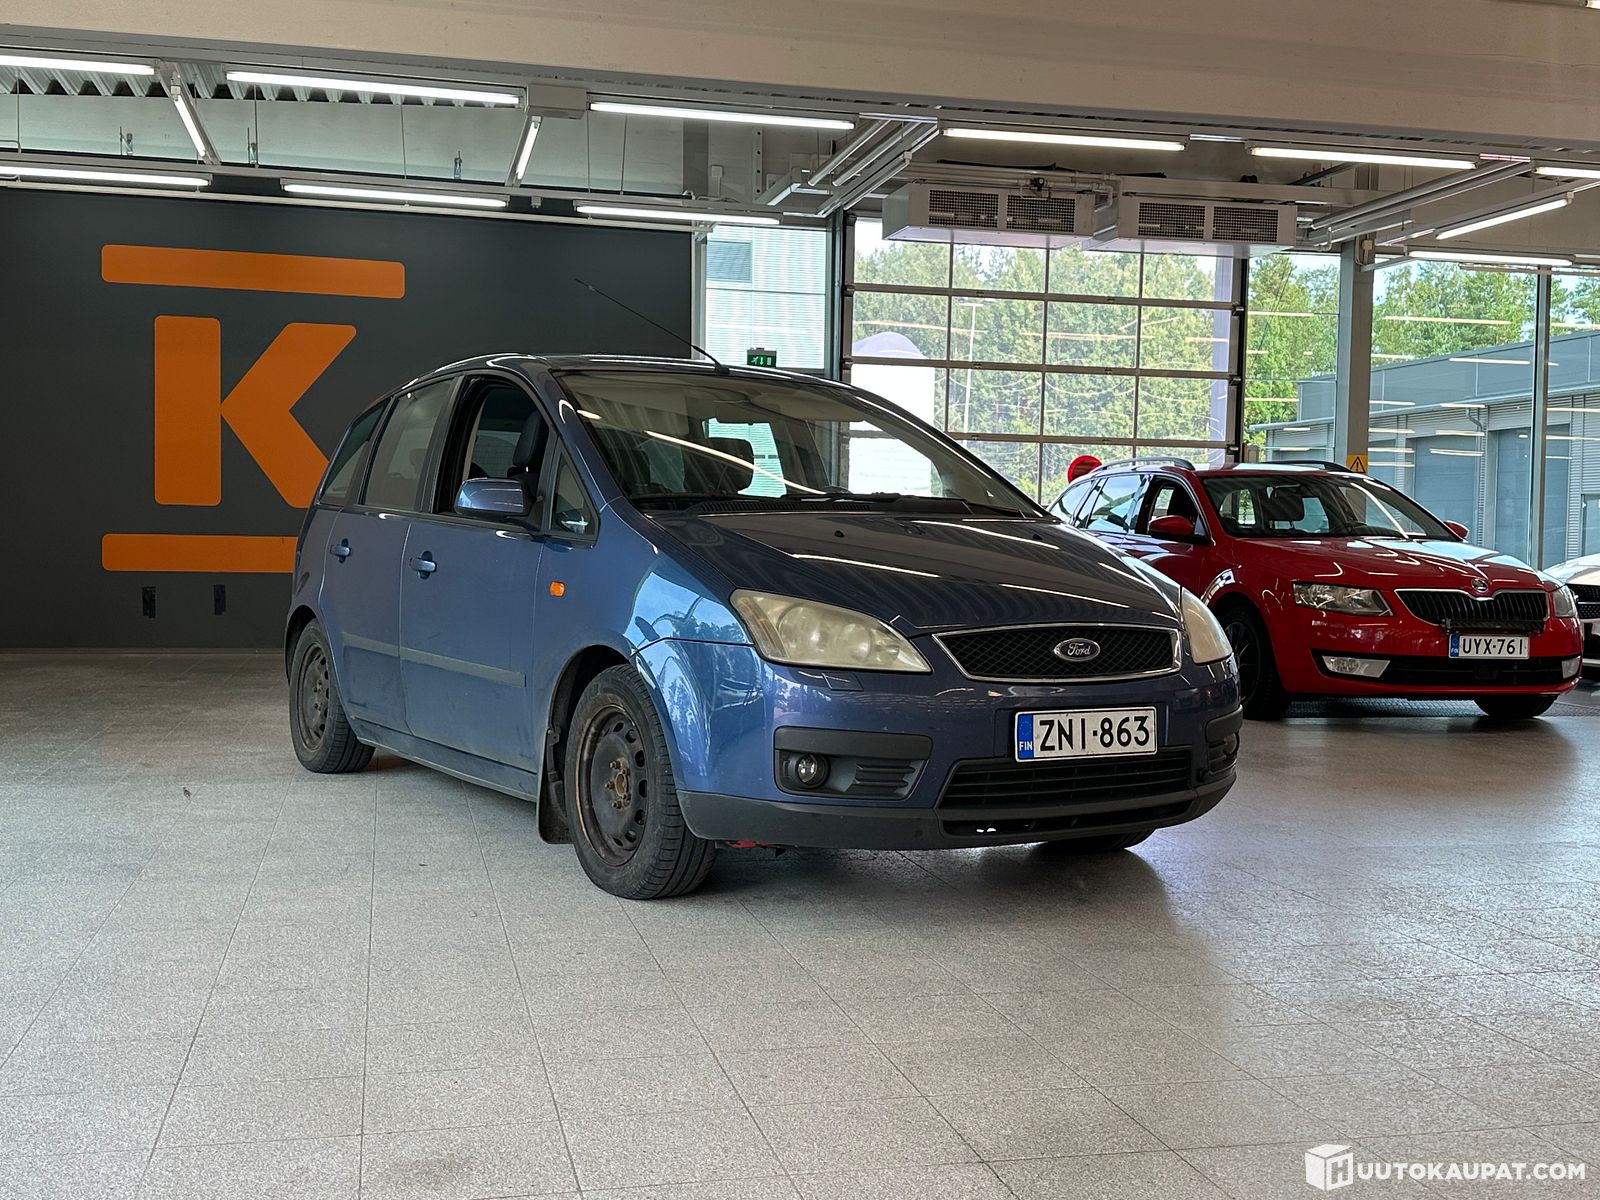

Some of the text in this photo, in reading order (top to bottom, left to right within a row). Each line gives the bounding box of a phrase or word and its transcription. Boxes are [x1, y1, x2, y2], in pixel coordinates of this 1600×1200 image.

[154, 315, 357, 508] K
[1067, 642, 1091, 656] Ford
[1463, 638, 1523, 655] UYX-761
[1019, 716, 1150, 752] FIN ZNI-863
